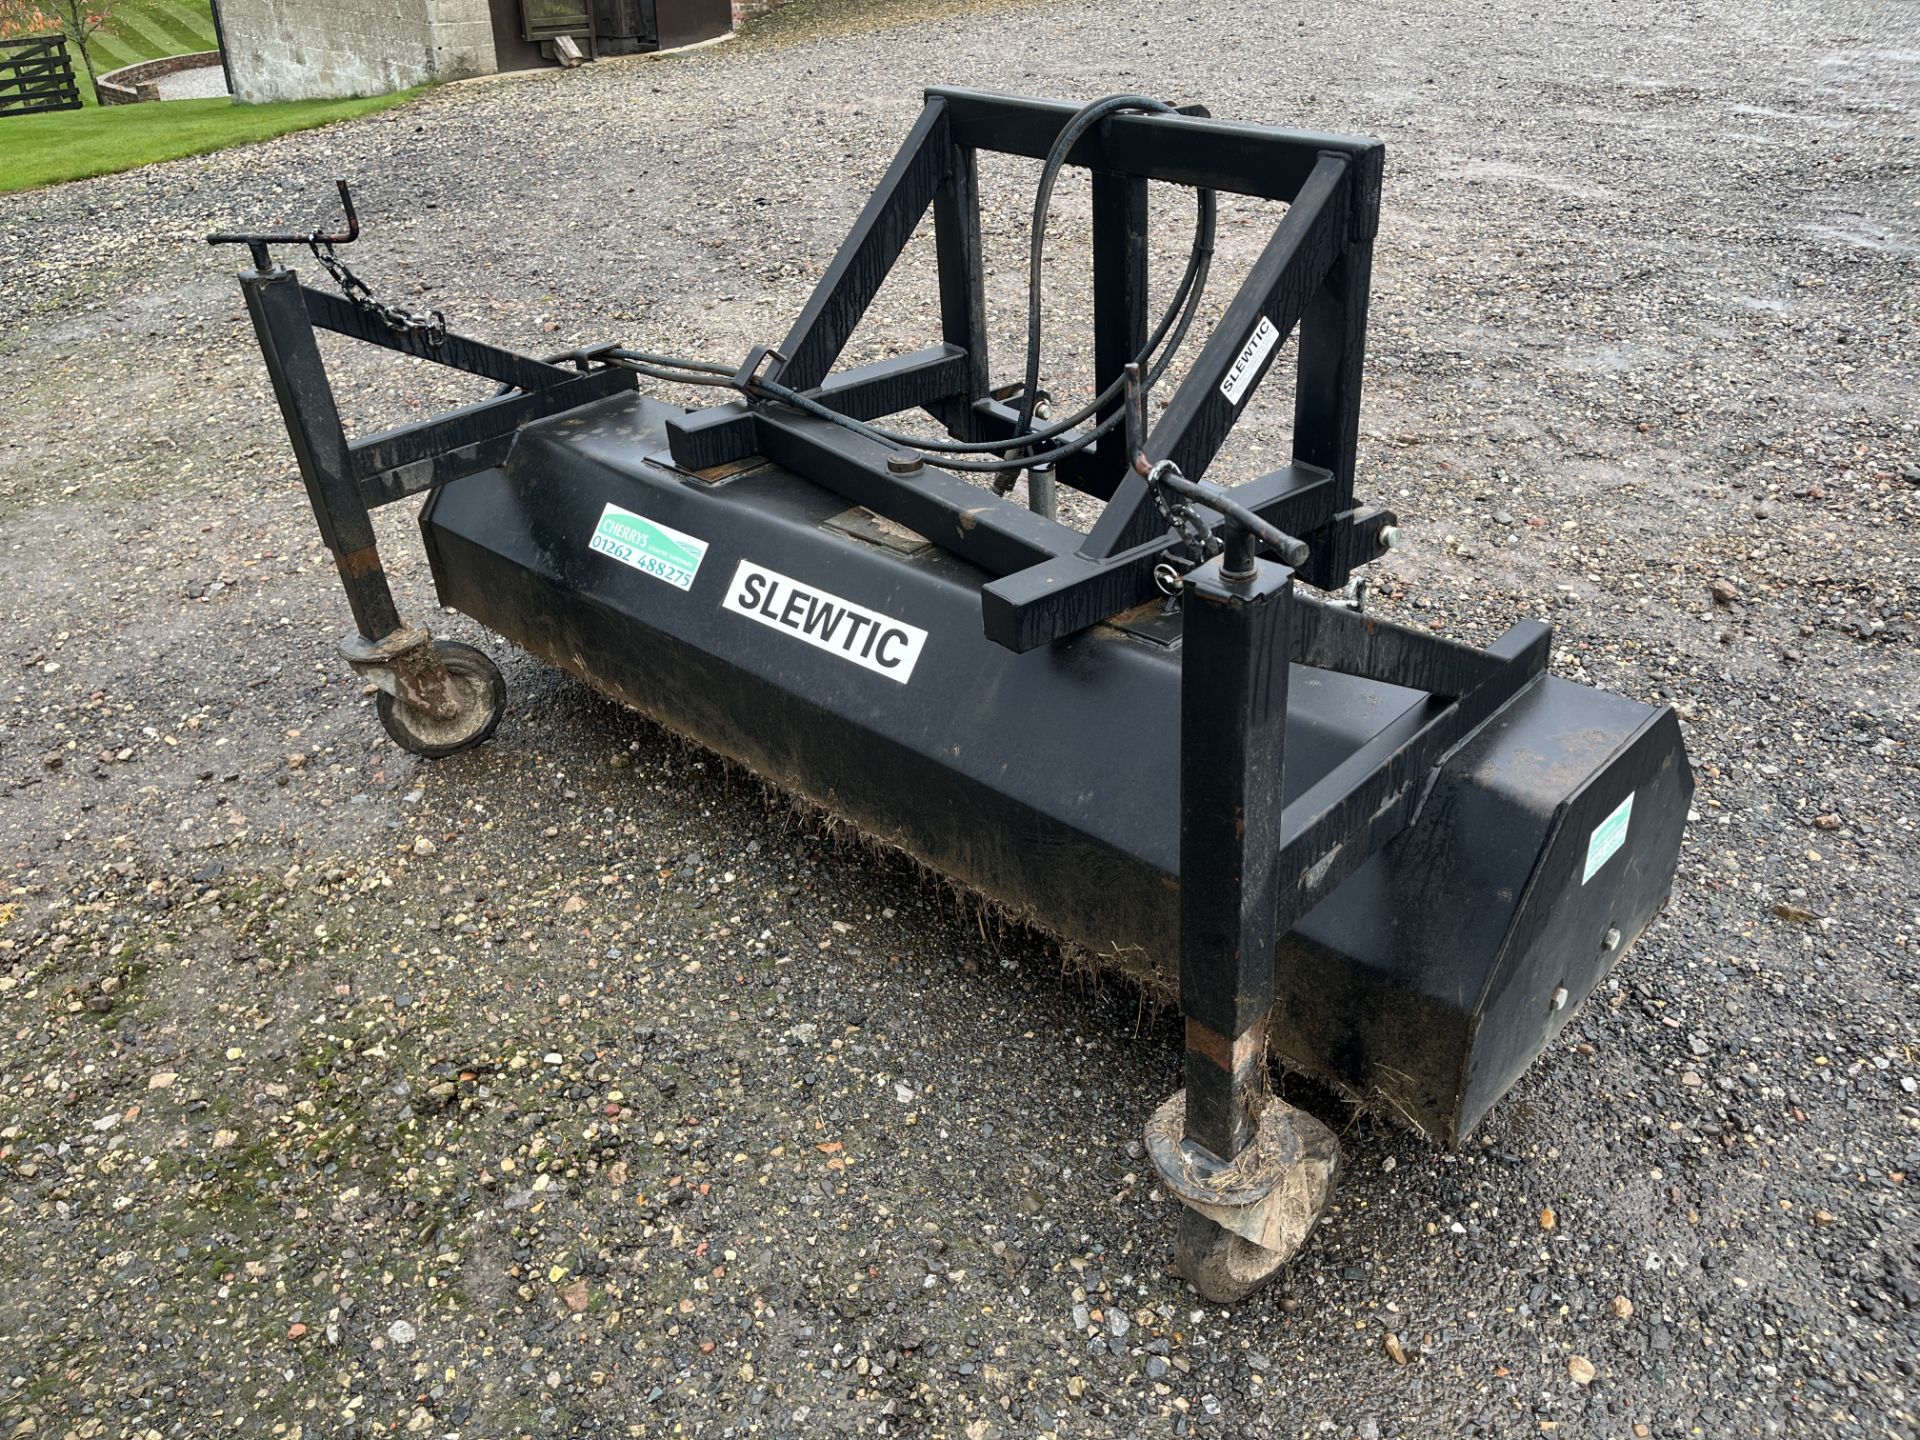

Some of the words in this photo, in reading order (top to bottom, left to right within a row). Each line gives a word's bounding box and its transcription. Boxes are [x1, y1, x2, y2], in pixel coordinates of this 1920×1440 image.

[1223, 321, 1270, 392] SLEWTIC
[592, 535, 633, 562] 01262
[637, 555, 692, 587] 488275
[603, 518, 650, 548] CHERRYS
[738, 573, 909, 668] SLEWTIC
